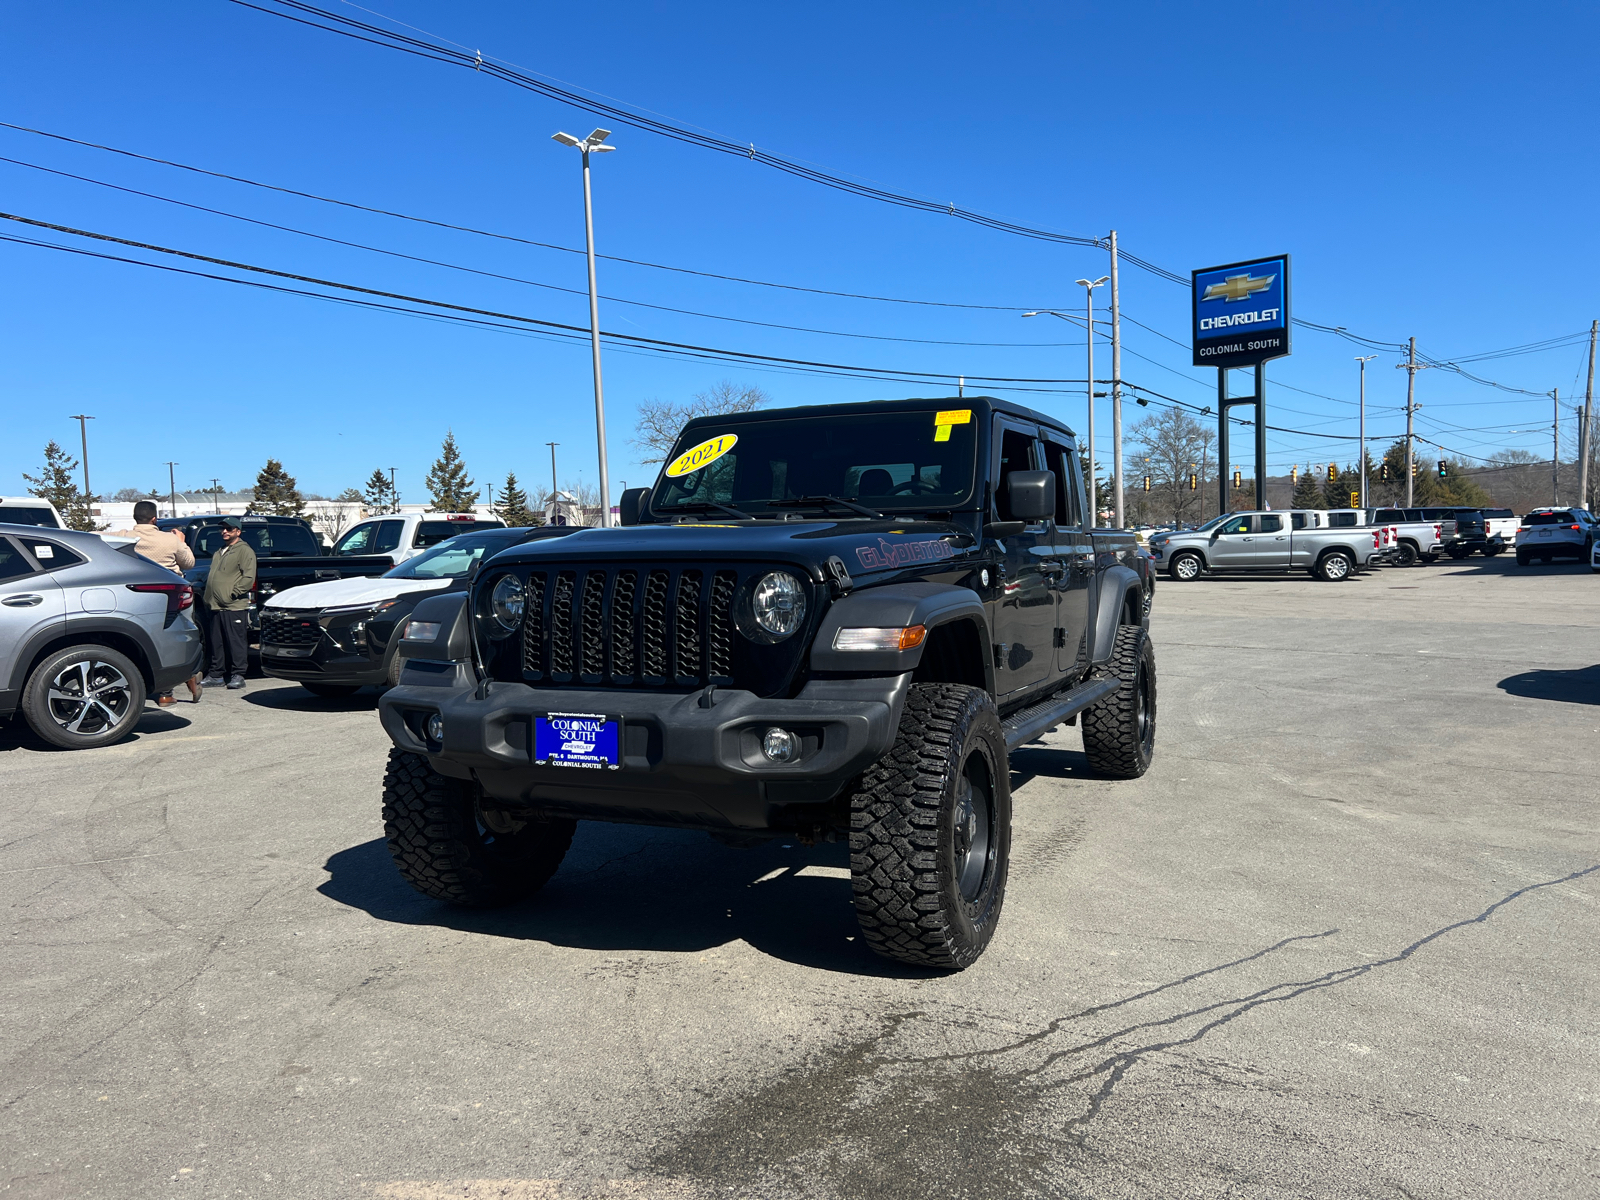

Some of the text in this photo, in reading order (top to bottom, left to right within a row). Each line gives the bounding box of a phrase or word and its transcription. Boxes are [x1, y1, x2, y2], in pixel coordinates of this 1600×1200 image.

[1200, 308, 1279, 330] CHEVROLET
[1200, 338, 1279, 356] COLONIAL SOUTH
[680, 439, 723, 472] 2021
[552, 720, 604, 732] COLONIAL
[560, 730, 596, 741] SOUTH
